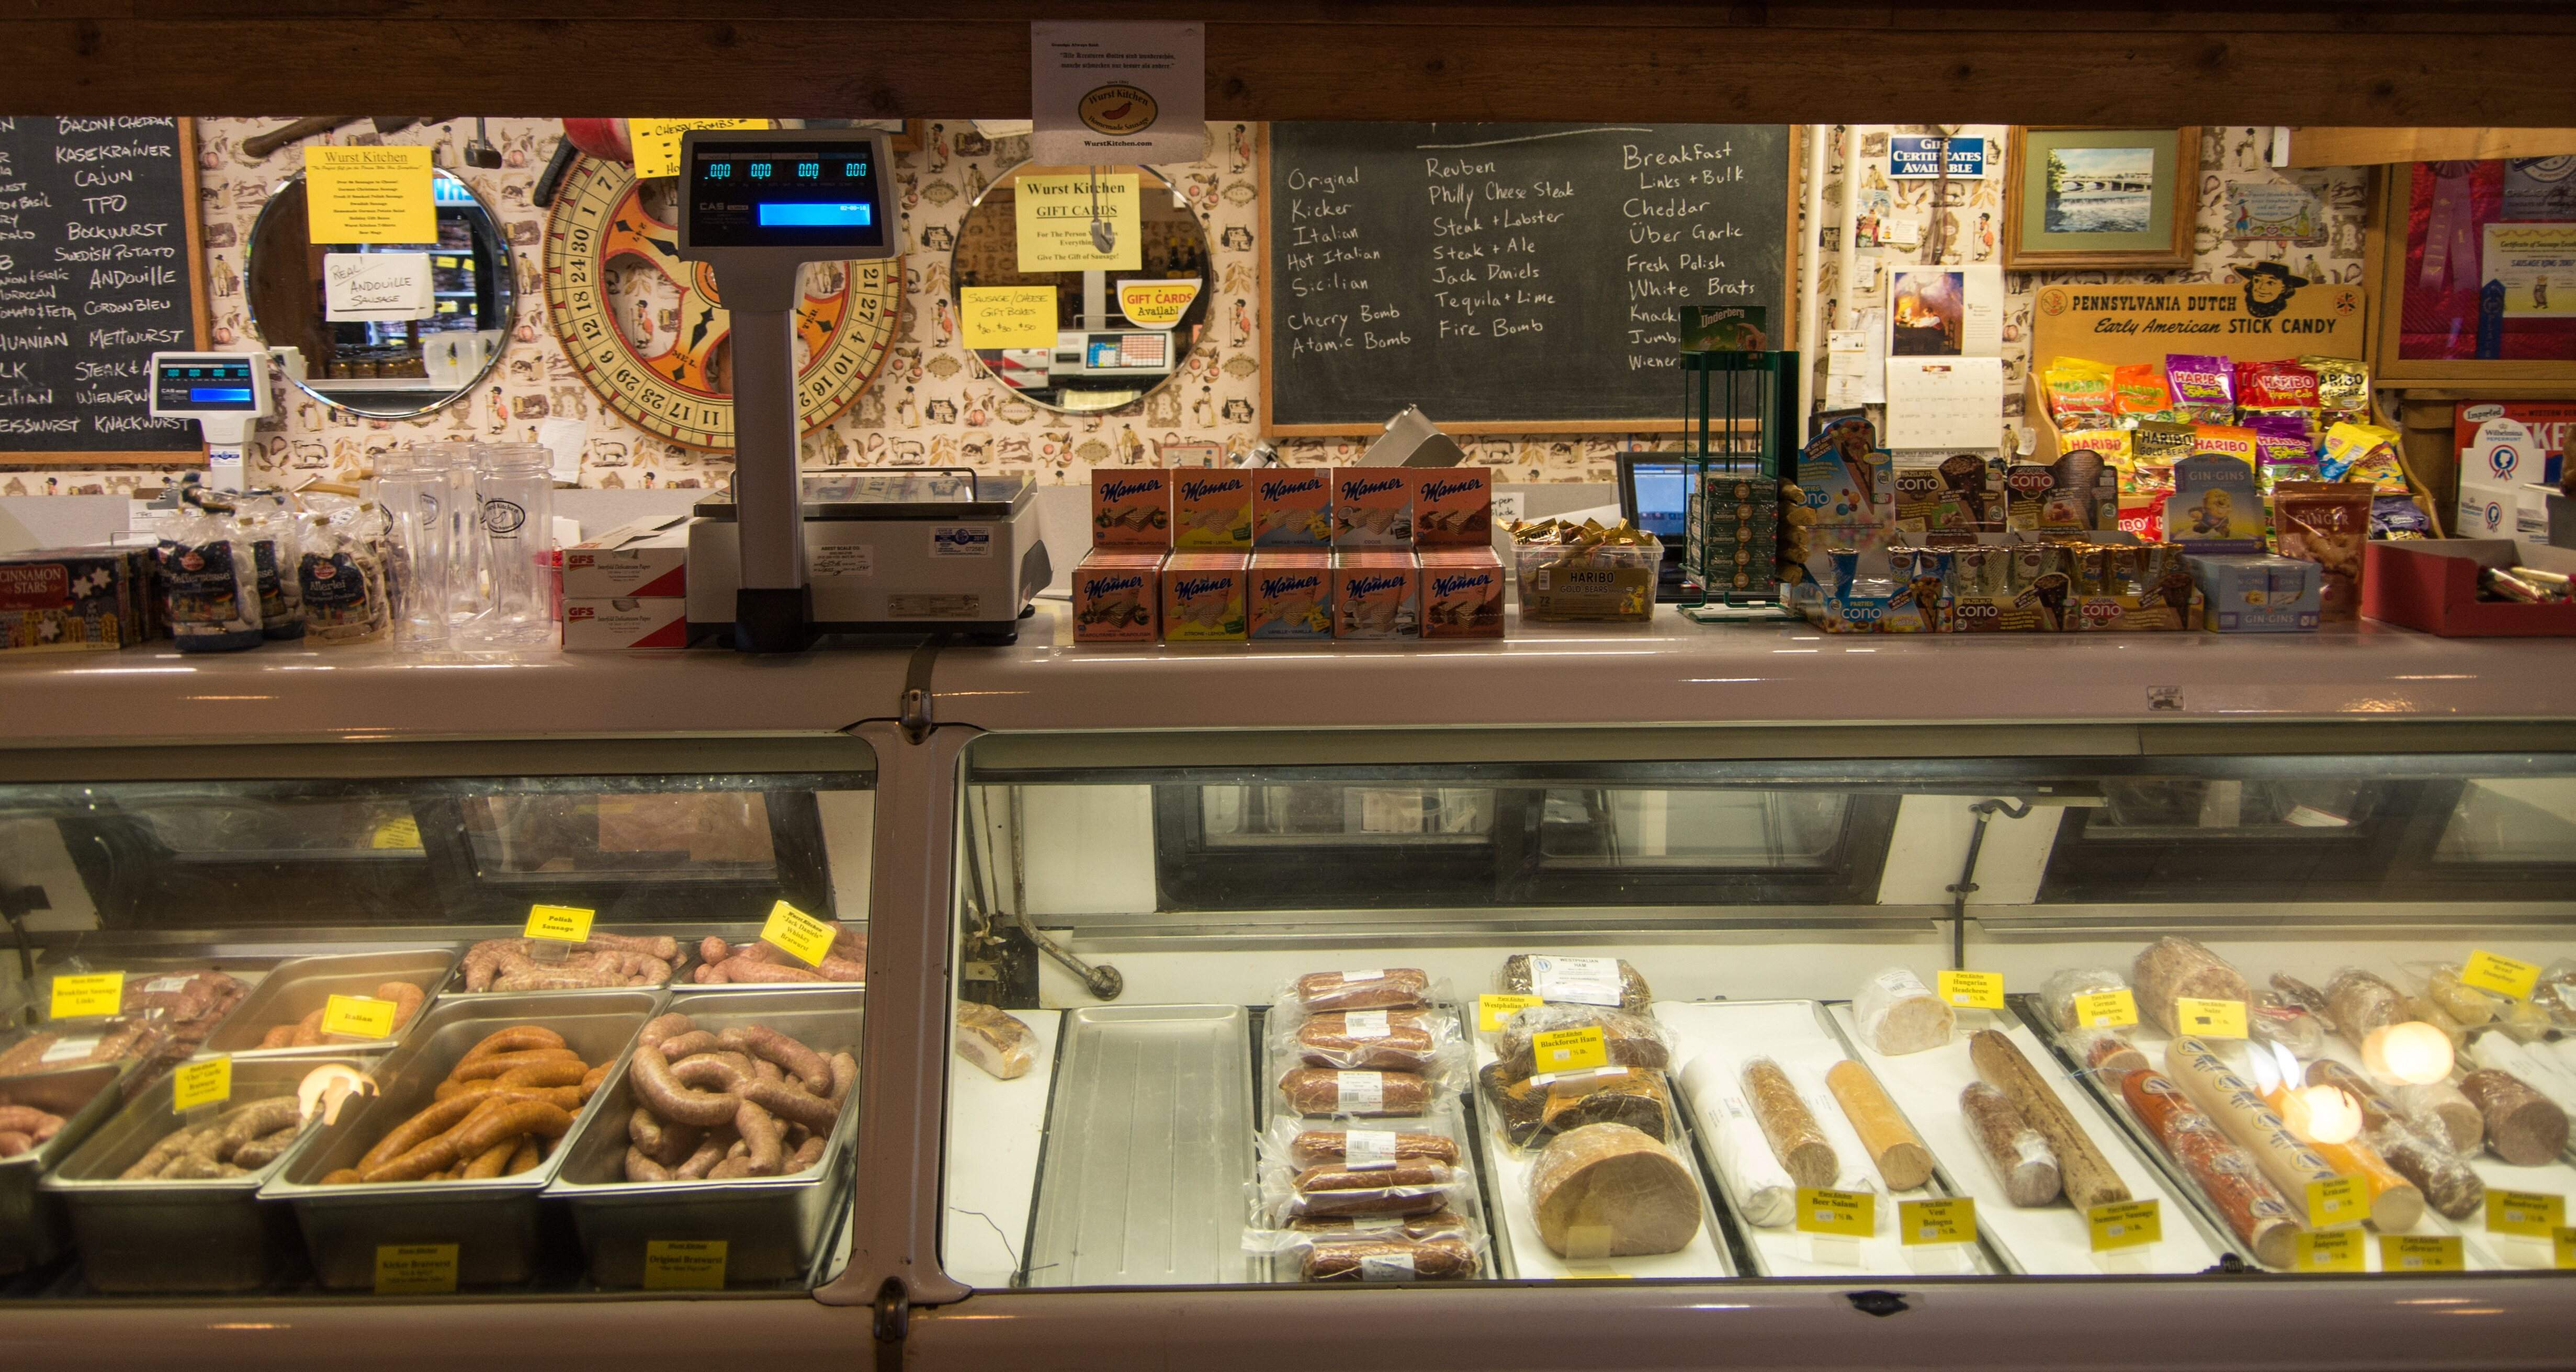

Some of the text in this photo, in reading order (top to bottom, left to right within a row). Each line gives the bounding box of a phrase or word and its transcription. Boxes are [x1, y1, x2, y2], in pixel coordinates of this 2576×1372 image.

[1088, 89, 1148, 106] Wurst Kitchen
[1088, 116, 1149, 131] Homemade Sausage
[325, 151, 408, 163] Wurst Kitchen
[1623, 141, 1732, 170] Breakfast
[75, 166, 132, 186] CAJUN
[1426, 158, 1496, 178] Reuben
[1641, 166, 1744, 189] Links Bulk
[1027, 183, 1069, 195] Wurst
[1289, 166, 1359, 194] Original
[82, 195, 127, 214] TPO
[1429, 182, 1575, 220] Philly Cheese Steak
[1623, 198, 1710, 218] Cheddar
[1036, 206, 1068, 217] GIFT
[1292, 199, 1352, 223] Kicker
[66, 222, 168, 240] BOCKWURST
[1433, 209, 1564, 237] Steak Lobster
[573, 229, 590, 252] 30
[1293, 226, 1359, 245] Italian
[1630, 222, 1743, 244] Über Garlic
[54, 244, 174, 262] SWEDISH POTATO
[1433, 237, 1536, 260] Steak Ale
[1287, 247, 1381, 271] Hot Italian
[1626, 254, 1725, 273] Fresh Polish
[572, 259, 586, 282] 24
[863, 268, 878, 288] 21
[1432, 264, 1540, 284] Jack Daniels
[1292, 273, 1369, 297] Sicilian
[1629, 278, 1756, 300] White Brats
[351, 295, 400, 307] SAUSAGE
[573, 291, 590, 311] 18
[1127, 292, 1192, 305] GIFT CARDS
[1435, 290, 1556, 316] Tequila Lime
[2072, 296, 2237, 311] PENNSYLVANIA DUTCH
[860, 299, 877, 322] 27
[1288, 303, 1400, 337] Cherry Bomb
[1701, 308, 1745, 328] Underberg
[582, 320, 600, 341] 12
[1440, 318, 1543, 338] Fire Bomb
[2094, 318, 2336, 335] Early American STICK CANDY
[1292, 332, 1411, 359] Atomic Bomb
[75, 362, 128, 381] STEAK
[2263, 375, 2314, 389] HARIBO
[641, 389, 665, 409] 23
[669, 402, 690, 420] 17
[2467, 406, 2502, 419] Imported
[2142, 430, 2192, 446] HARIBO
[2485, 429, 2523, 437] Wilhelmina
[2072, 439, 2121, 450] HARIBO
[2196, 438, 2249, 452] HARIBO
[1181, 479, 1244, 502] Manner
[1260, 478, 1323, 502] Manner
[1341, 478, 1404, 501] Manner
[1420, 478, 1484, 502] Manner
[1894, 478, 1939, 491] cono
[2008, 474, 2053, 488] cono
[1100, 479, 1163, 503] Manner
[569, 555, 594, 564] GFS
[1260, 575, 1321, 599] Manner
[1346, 575, 1407, 599] Manner
[1432, 574, 1494, 598] Manner
[1571, 572, 1614, 584] HARIBO
[14, 582, 48, 594] STARS
[1084, 576, 1144, 600] Manner
[1174, 576, 1234, 600] Manner
[1560, 585, 1608, 594] GOLD-BEARS
[569, 607, 594, 616] GFS
[1841, 607, 1882, 620] cono
[1956, 605, 1998, 617] cono
[2081, 604, 2122, 616] cono
[542, 924, 574, 932] Sausage
[787, 926, 810, 944] Whiskey
[781, 933, 809, 951] Bratwurst
[76, 996, 95, 1005] Links
[2094, 1000, 2117, 1008] German
[344, 1012, 373, 1024] Italian
[2091, 1007, 2123, 1017] Headcheese
[1541, 1035, 1597, 1048] Blackforest Ham
[1812, 1198, 1858, 1209] Beer Salami
[1923, 1219, 1953, 1227] Bologna
[2094, 1210, 2154, 1225] Summer Sausage
[650, 1255, 682, 1264] Original
